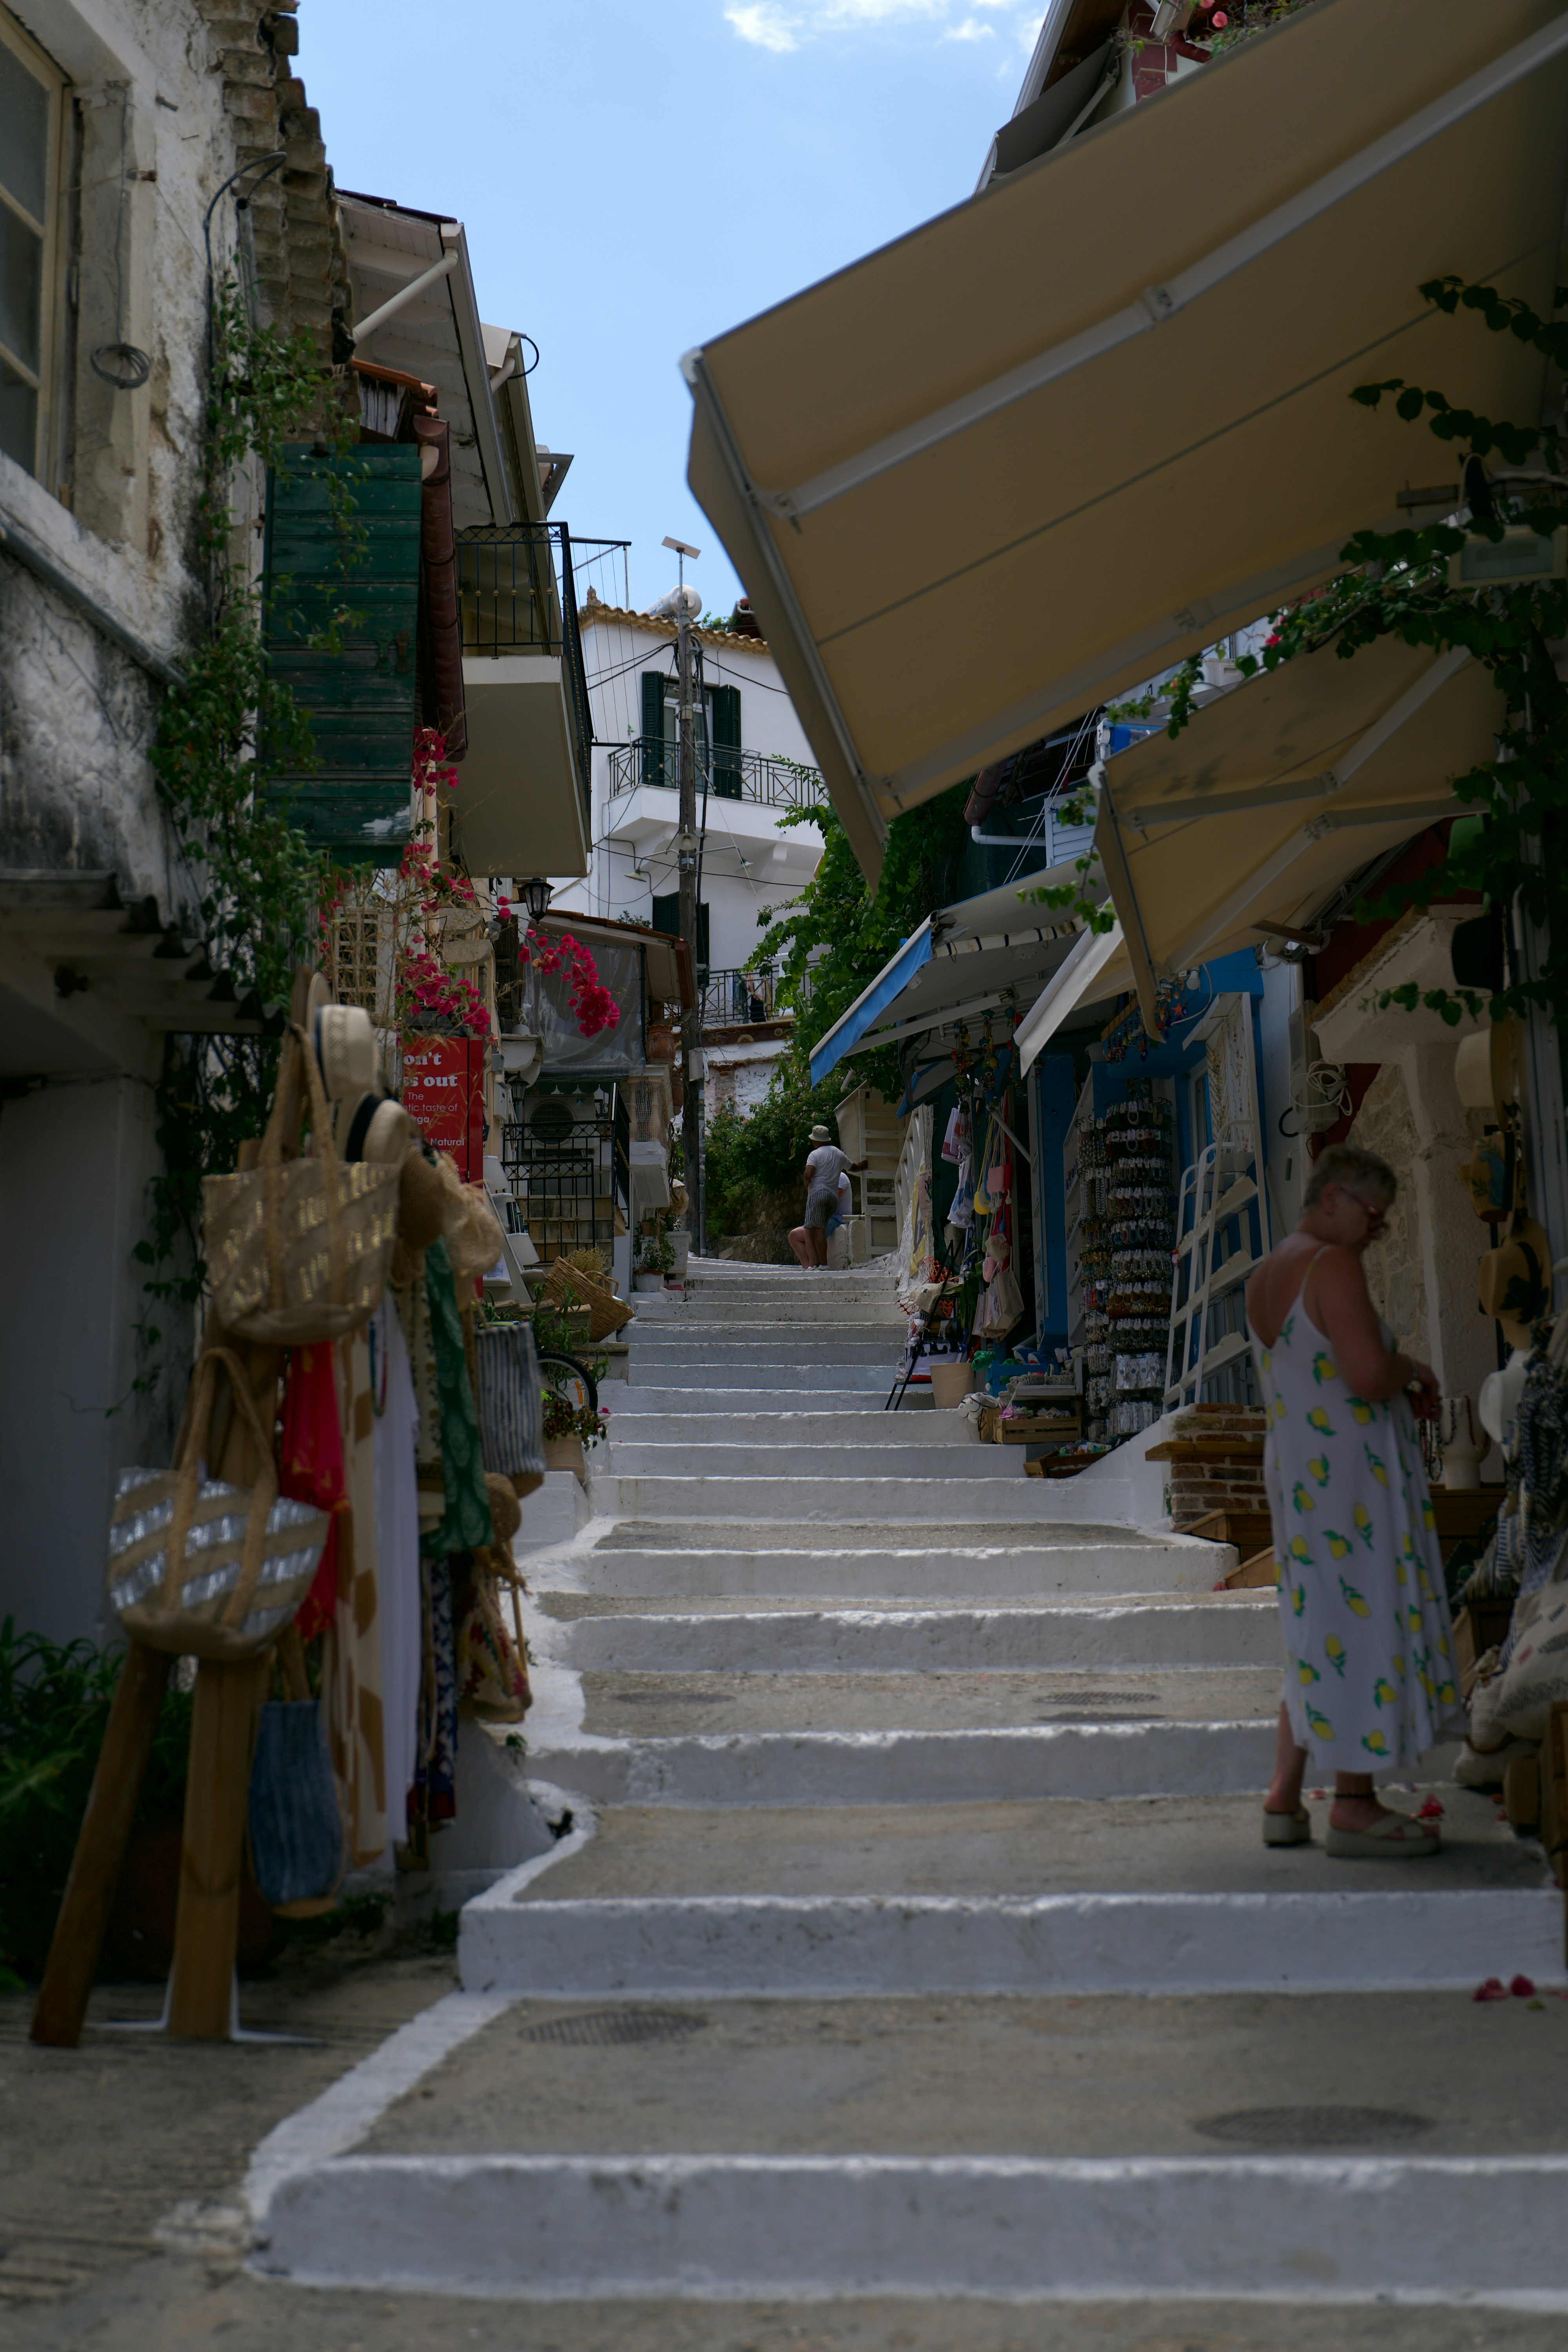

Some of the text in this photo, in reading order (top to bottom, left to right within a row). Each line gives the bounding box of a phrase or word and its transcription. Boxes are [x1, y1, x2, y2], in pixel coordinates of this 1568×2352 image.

[403, 1051, 442, 1065] on't
[403, 1074, 458, 1087] ss out
[407, 1092, 424, 1100] The
[403, 1103, 458, 1112] ntic taste of
[413, 1116, 430, 1125] rga
[430, 1138, 465, 1146] Natural
